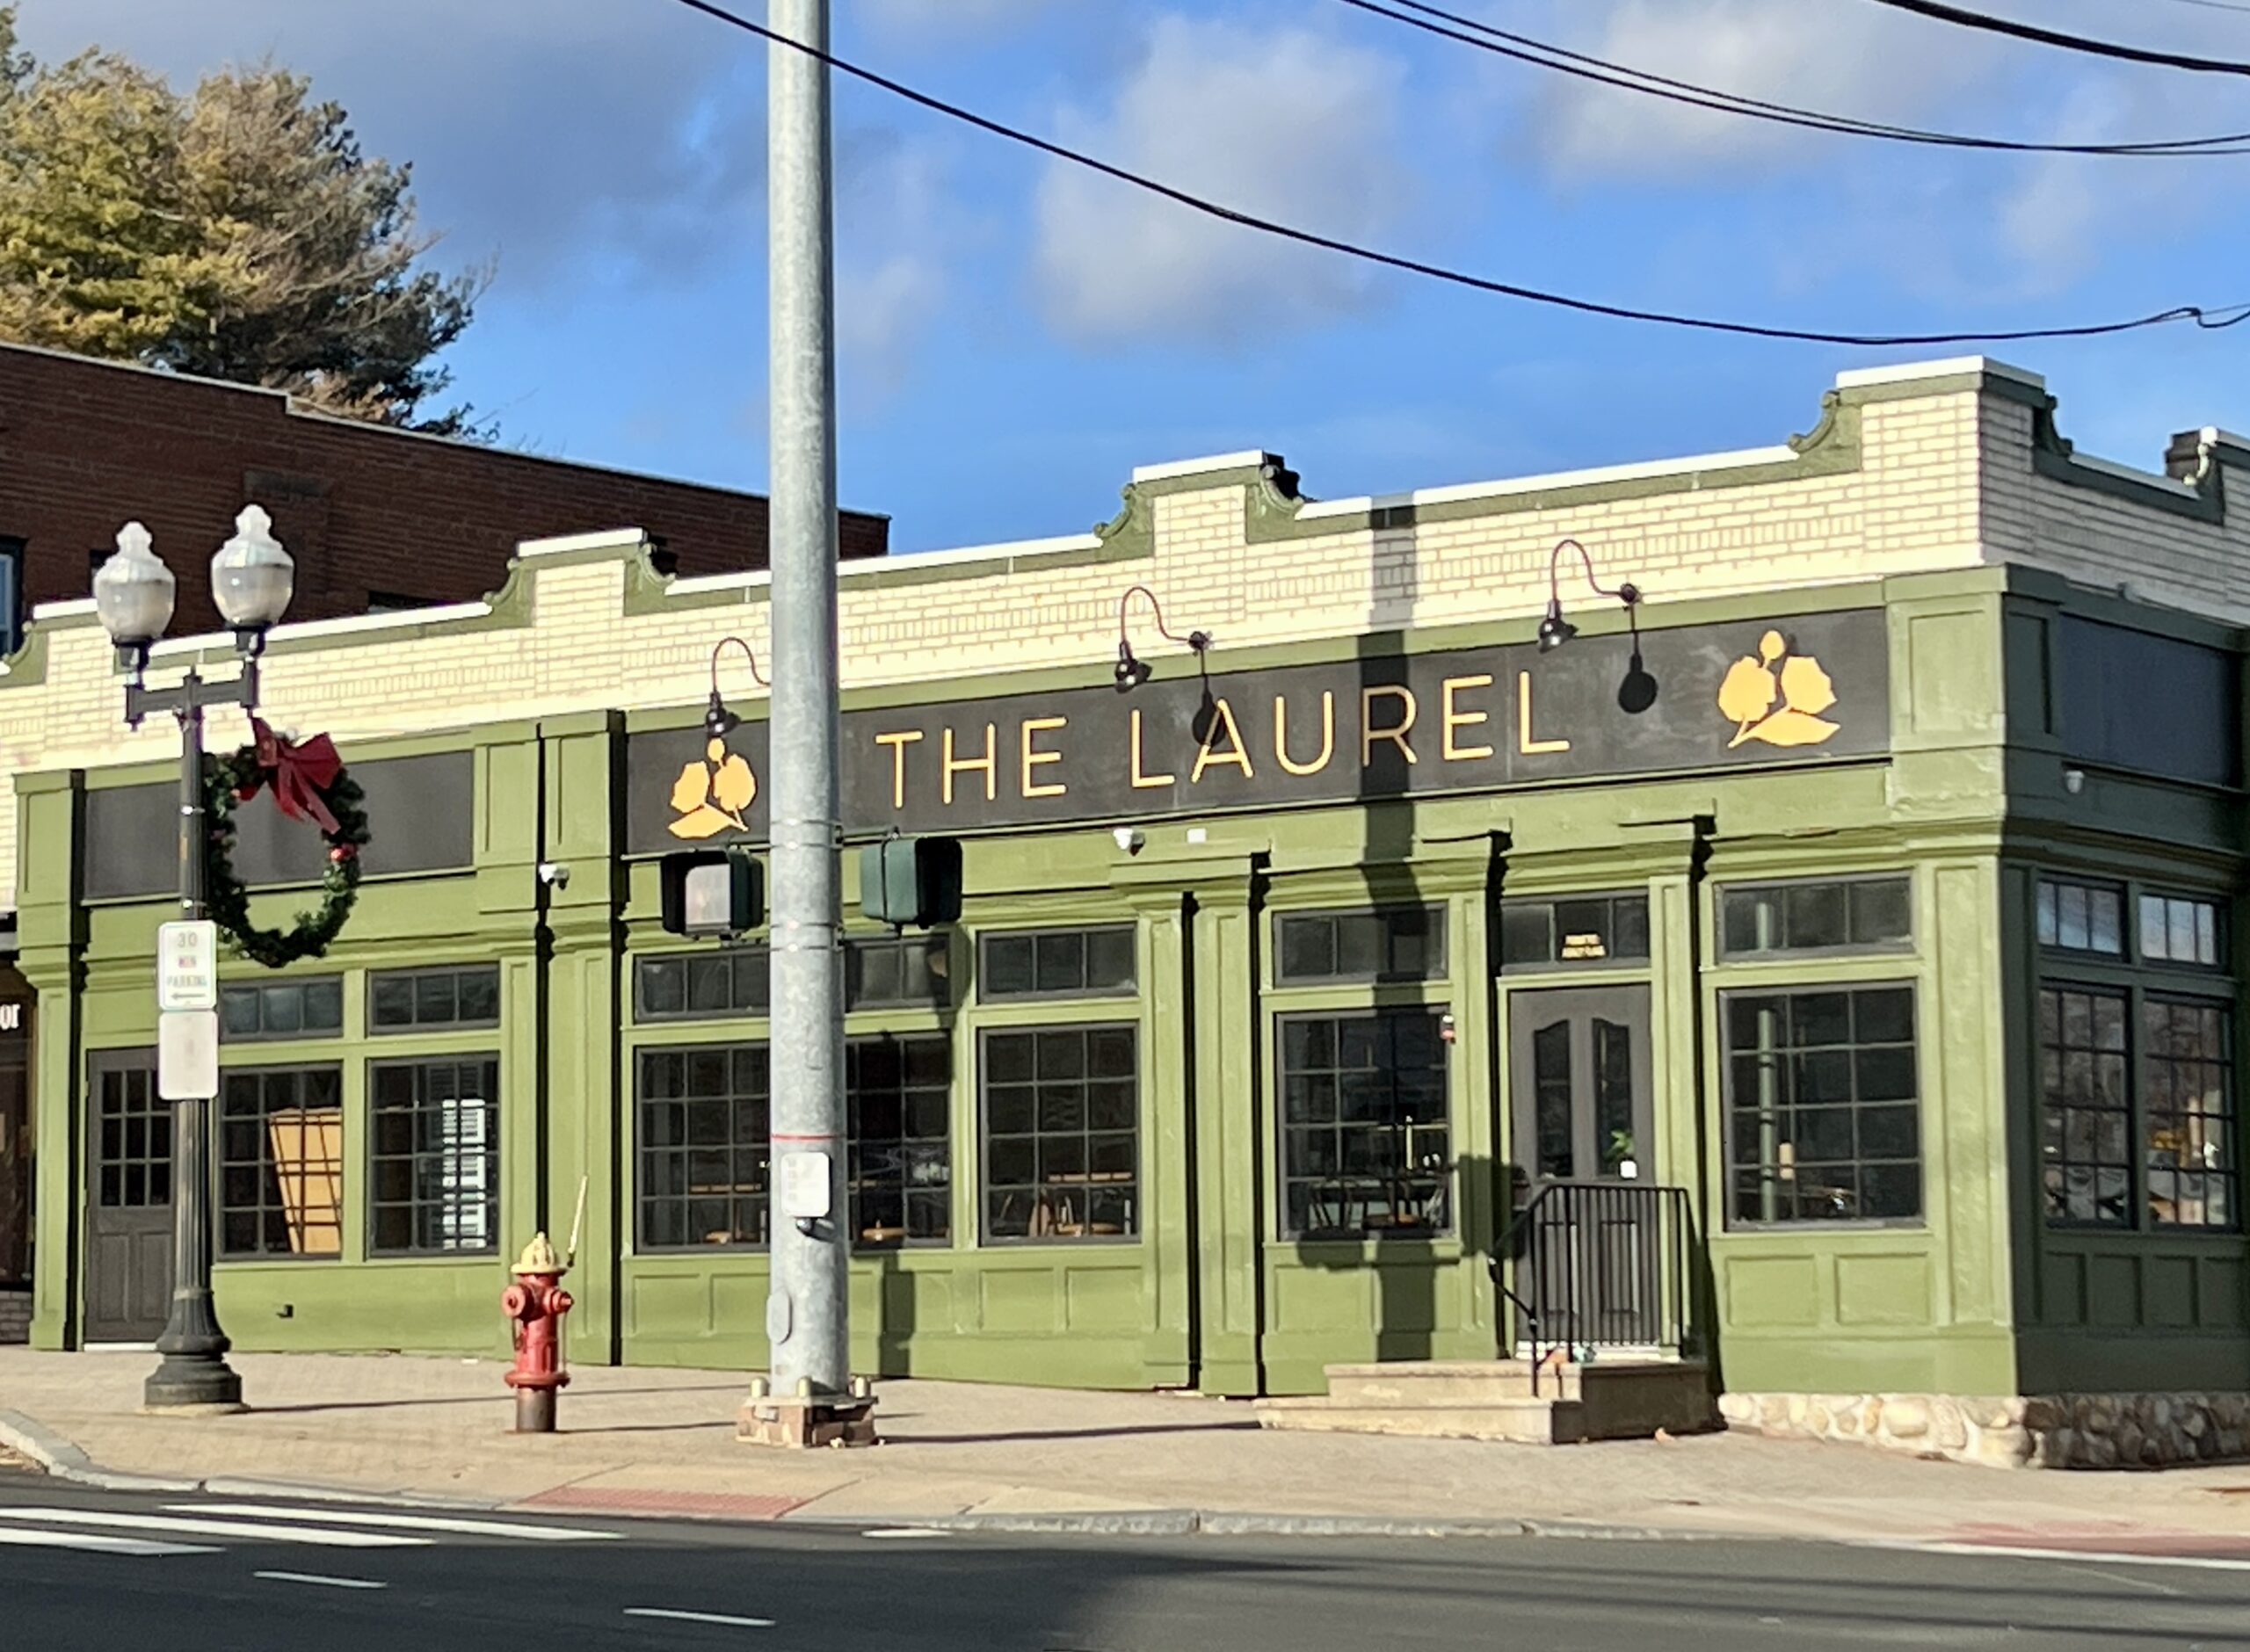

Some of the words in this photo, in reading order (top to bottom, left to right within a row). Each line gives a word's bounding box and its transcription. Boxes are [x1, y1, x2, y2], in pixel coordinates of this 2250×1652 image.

[875, 715, 1067, 809] THE
[1130, 670, 1571, 789] LAUREL
[177, 931, 199, 949] 30
